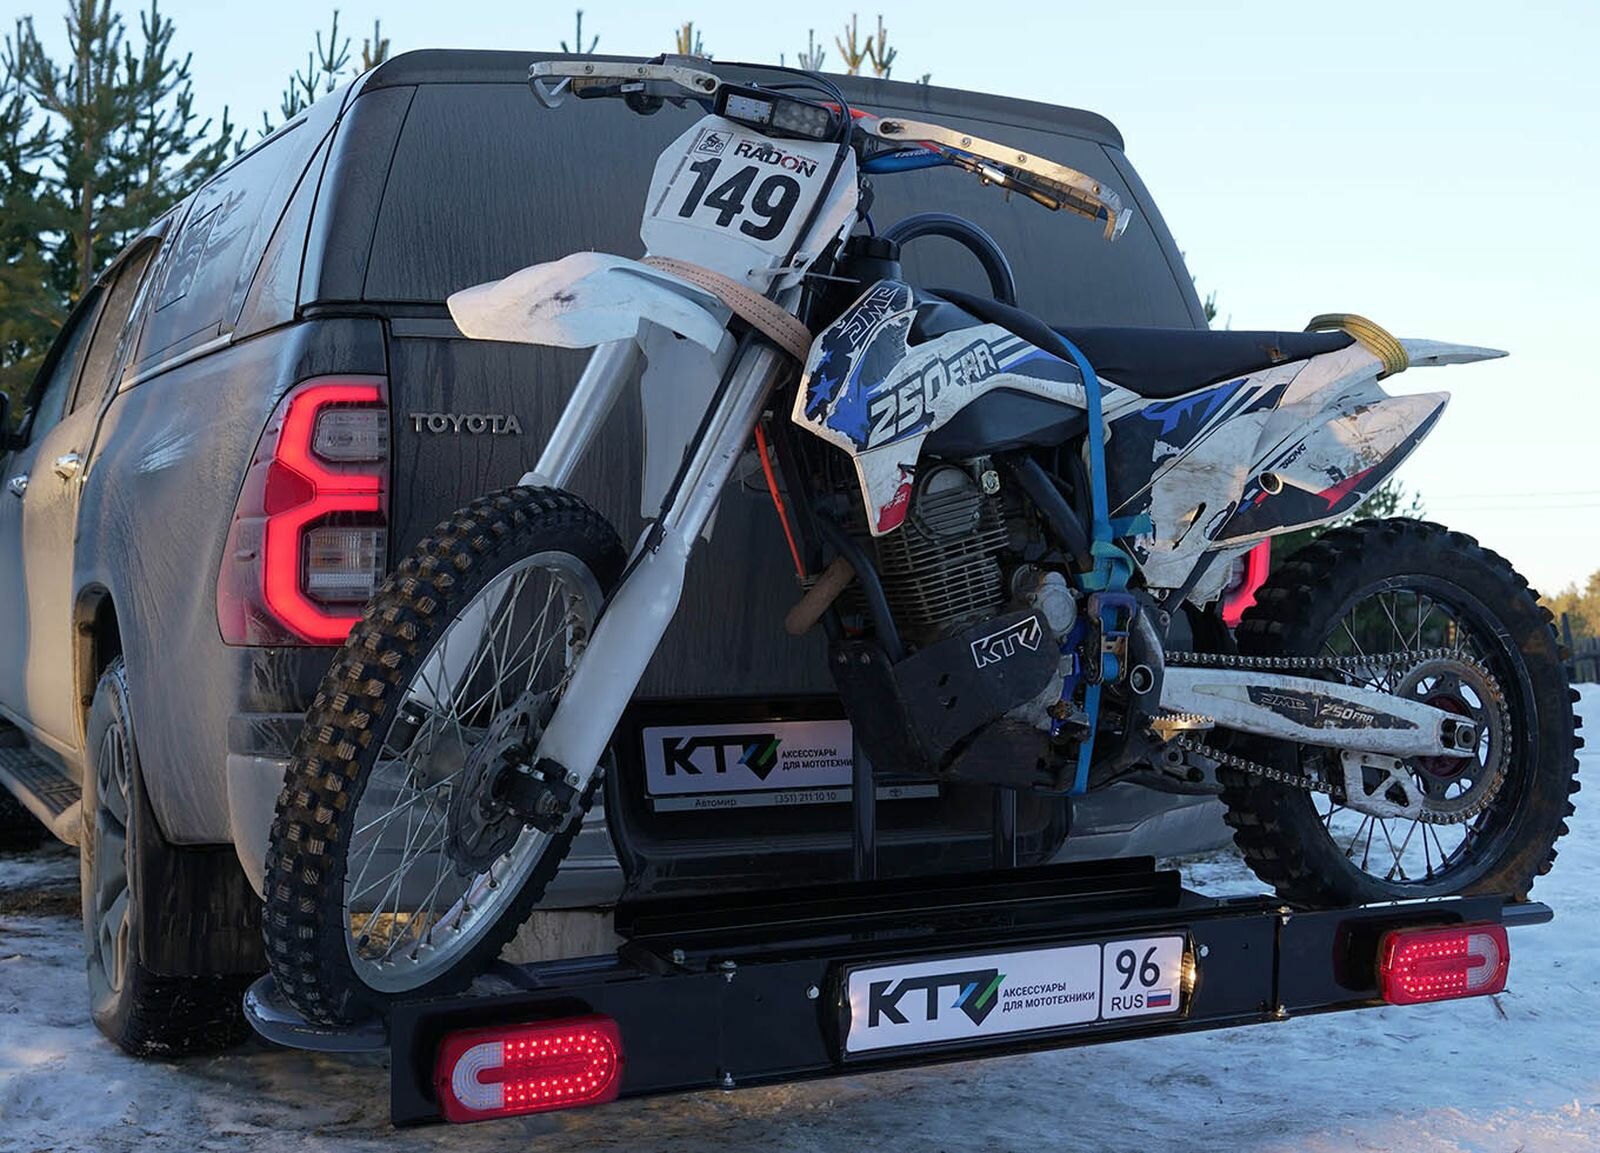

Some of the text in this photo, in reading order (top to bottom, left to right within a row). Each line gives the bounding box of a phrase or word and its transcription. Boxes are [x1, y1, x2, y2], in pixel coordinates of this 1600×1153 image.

[734, 142, 818, 178] RADON
[678, 157, 801, 241] 149
[409, 412, 523, 434] TOYOTA
[781, 748, 838, 760] АКСЕССУАРЫ
[782, 758, 853, 772] ДЛЯ МОТОТЕХНИ
[694, 798, 737, 810] Автомир
[1115, 946, 1161, 990] 96
[1002, 981, 1067, 998] АКСЕССУАРЫ
[1002, 991, 1096, 1013] ДЛЯ МОТОТЕХНИКИ
[1111, 995, 1144, 1012] RUS
